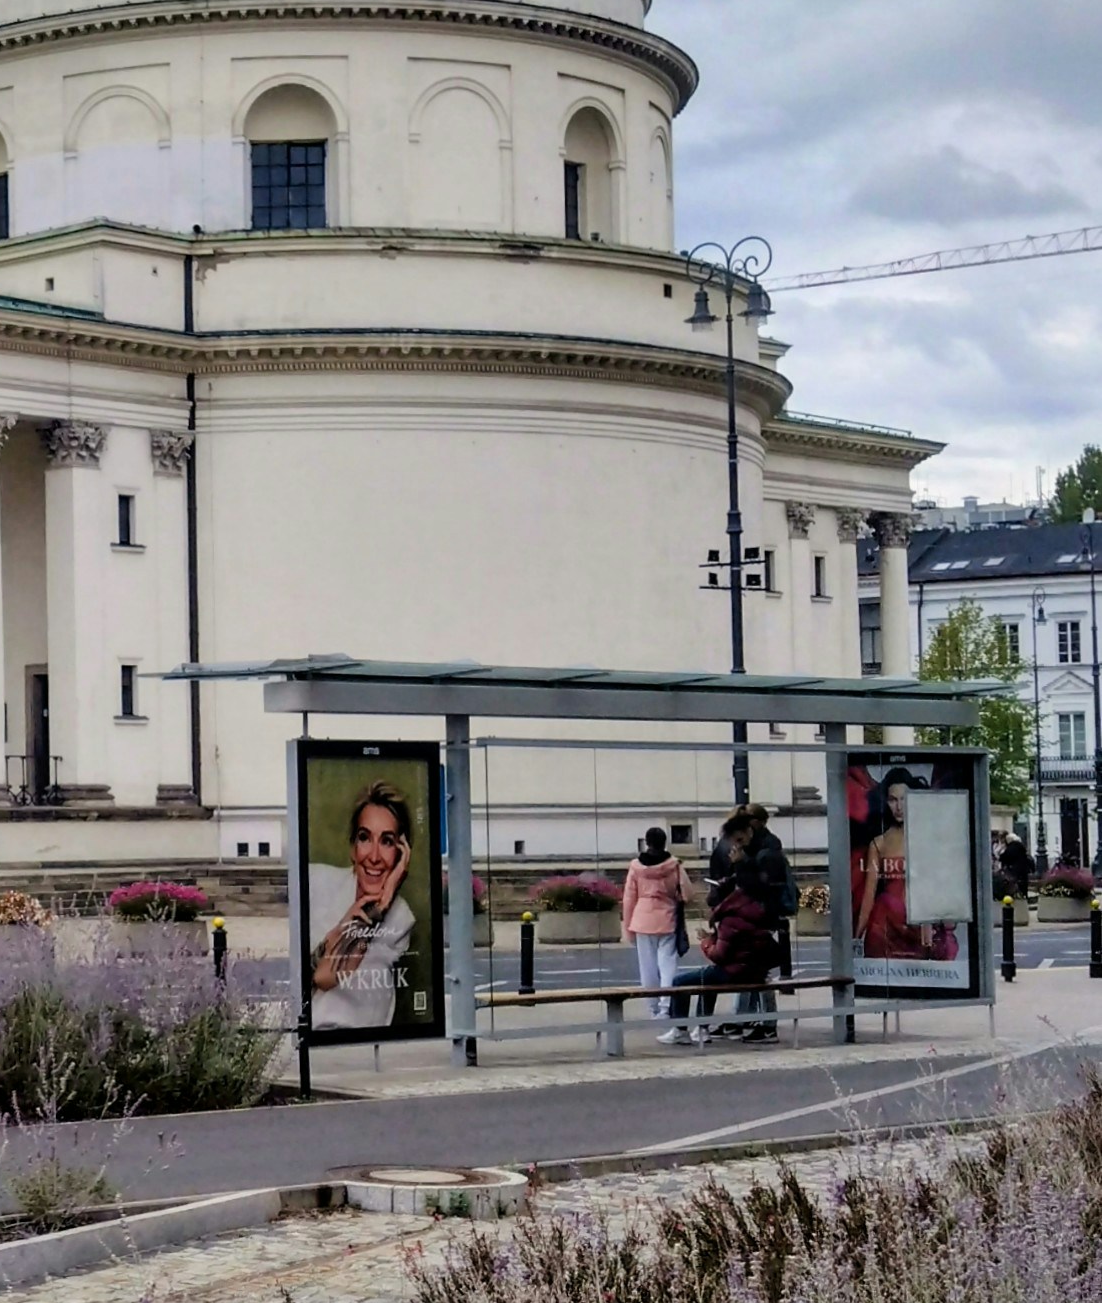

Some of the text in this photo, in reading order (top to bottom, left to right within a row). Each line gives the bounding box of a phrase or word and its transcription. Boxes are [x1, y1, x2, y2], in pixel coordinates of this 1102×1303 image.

[859, 858, 906, 872] LA BO
[340, 919, 403, 939] Freedom
[854, 966, 960, 979] AROLINA HERRERA
